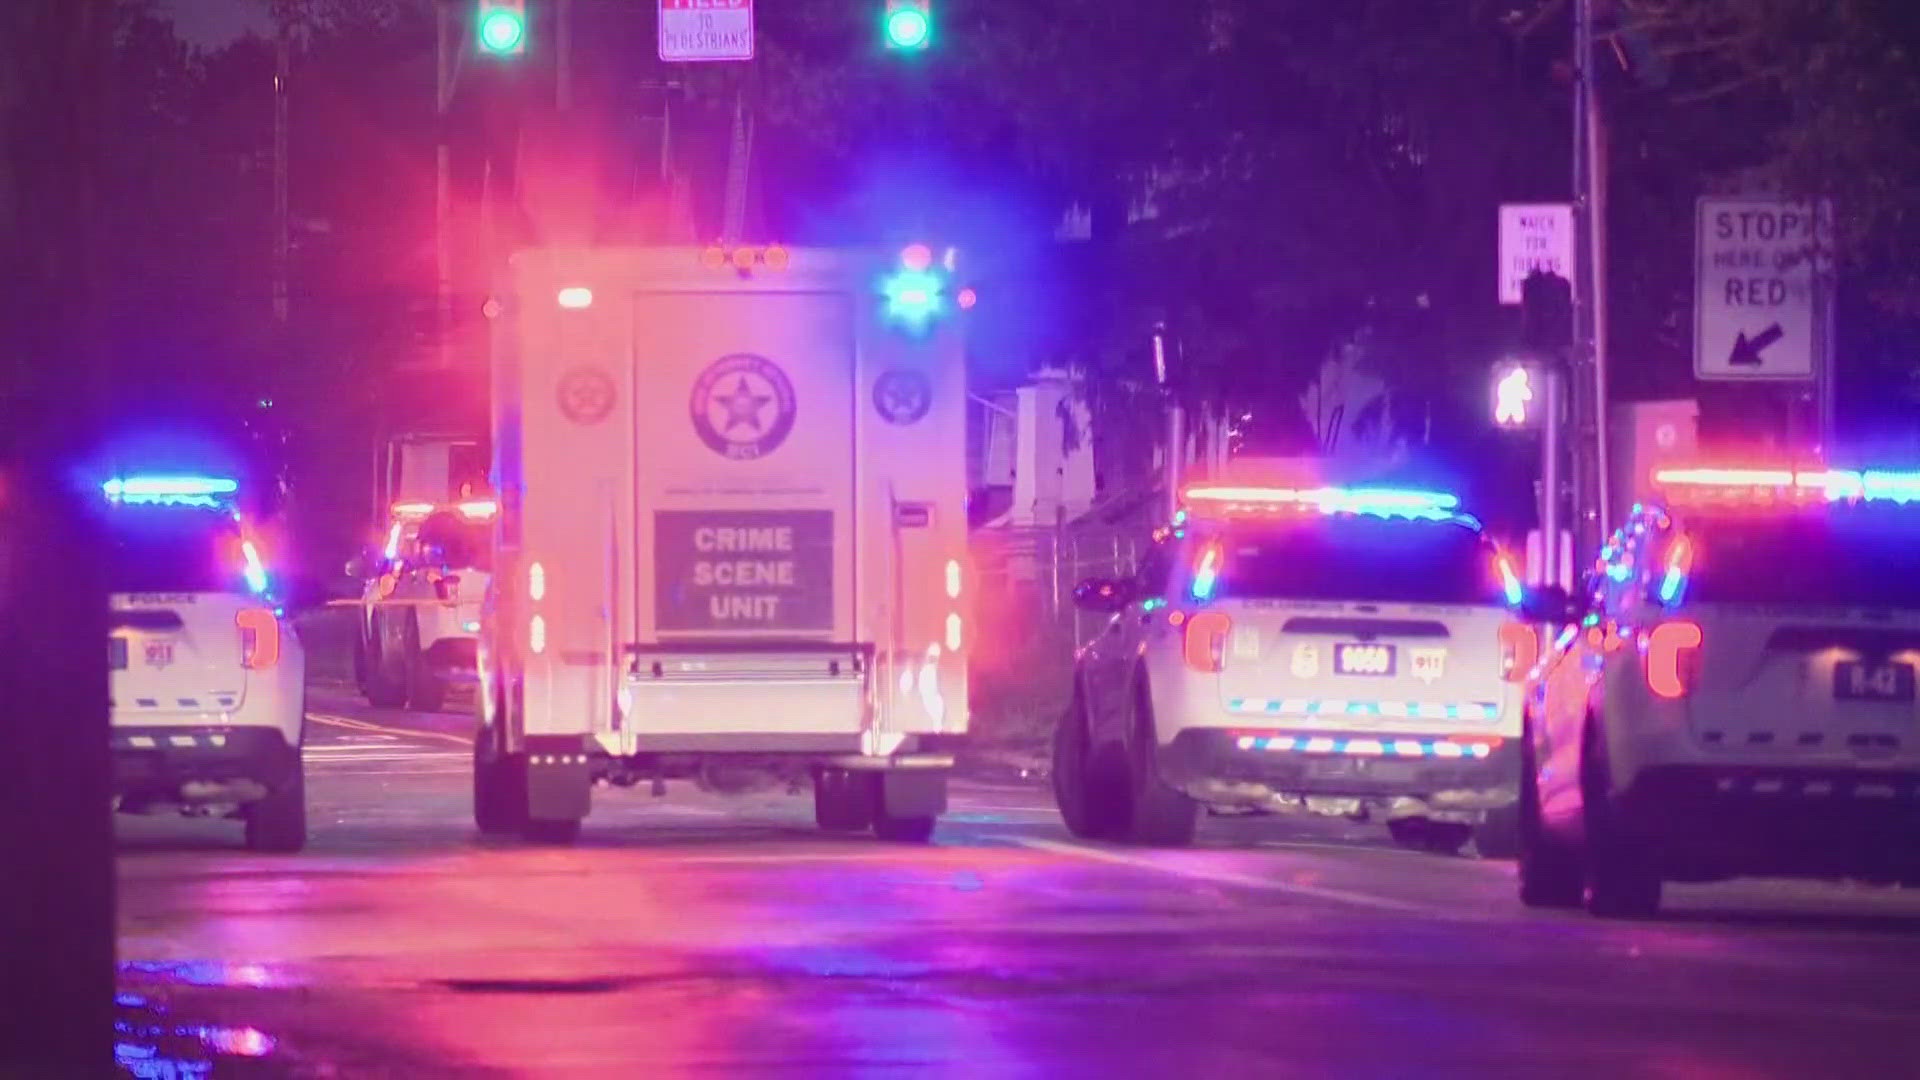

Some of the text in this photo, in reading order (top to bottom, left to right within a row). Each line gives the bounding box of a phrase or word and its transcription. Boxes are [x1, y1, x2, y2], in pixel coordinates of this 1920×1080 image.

[665, 32, 747, 49] PEDESTRIANS
[1716, 212, 1799, 240] STOP
[1726, 278, 1786, 306] RED
[694, 526, 793, 552] CRIME
[693, 561, 794, 586] SCENE
[128, 592, 197, 604] POLICE
[709, 596, 779, 620] UNIT
[1416, 656, 1440, 669] 911
